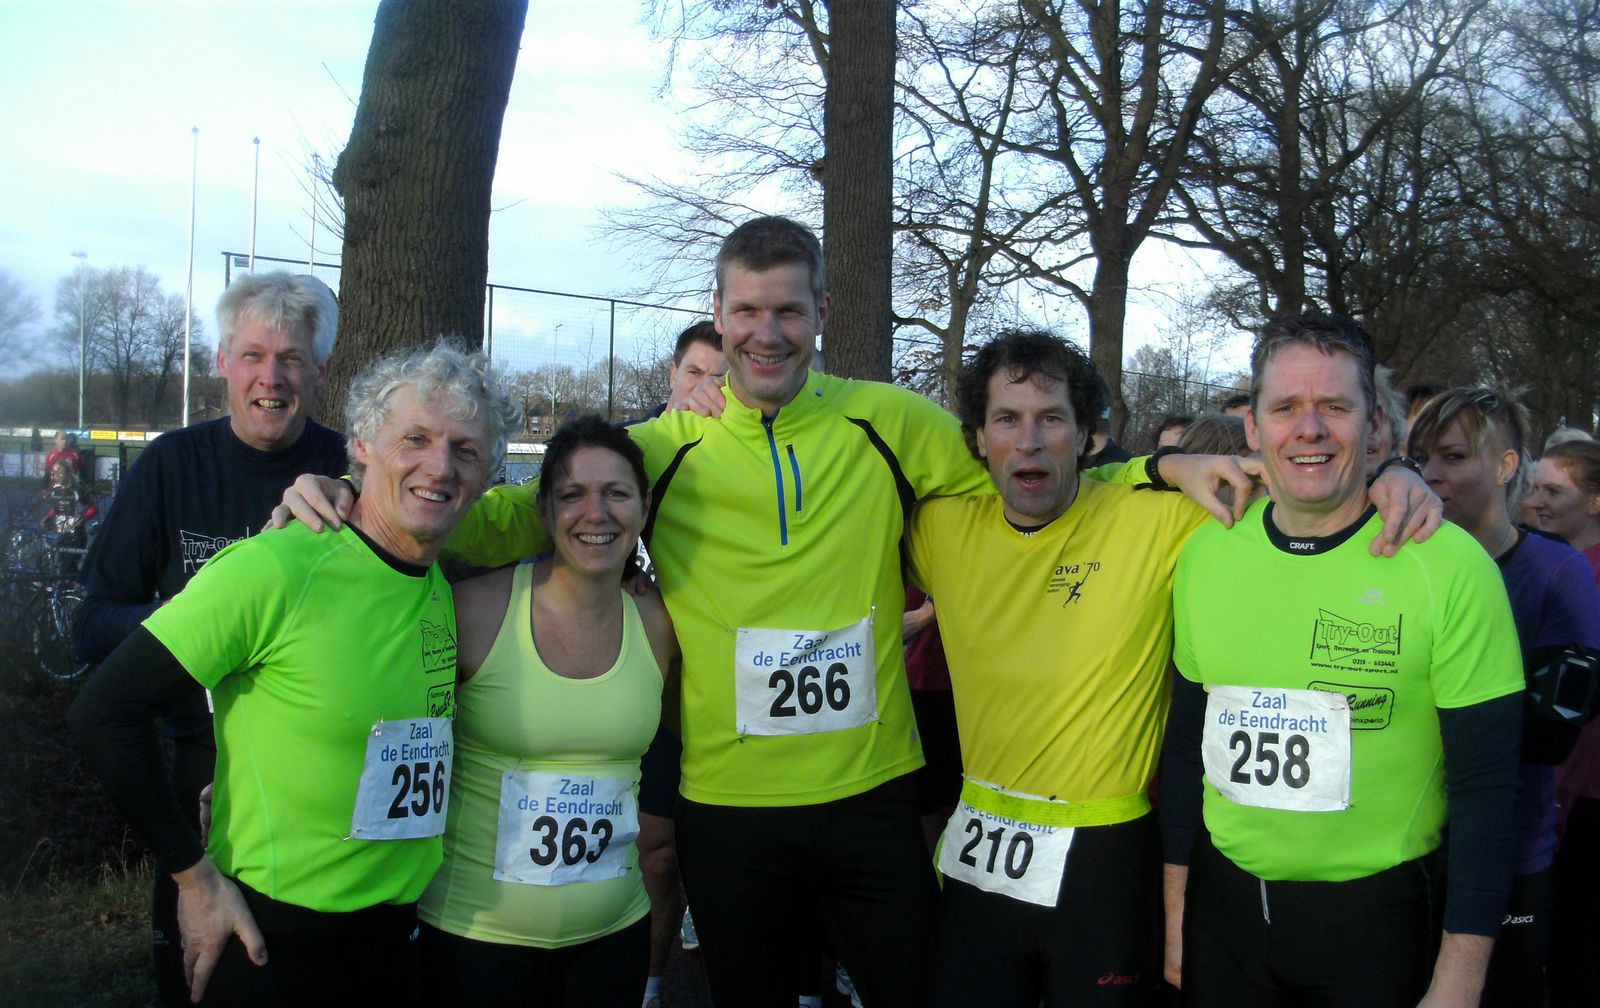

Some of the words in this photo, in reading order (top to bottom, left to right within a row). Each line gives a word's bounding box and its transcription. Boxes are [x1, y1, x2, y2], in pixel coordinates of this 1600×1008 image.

[182, 536, 244, 558] Try-O
[1055, 565, 1080, 575] ava
[793, 634, 829, 650] Zaal
[1319, 619, 1398, 645] Try-Out
[753, 651, 774, 667] de
[779, 642, 862, 667] Eendracht
[1373, 648, 1396, 656] Training
[1310, 662, 1399, 674] www.try-out-sport.nl
[768, 662, 851, 718] 266
[1251, 691, 1287, 710] Zaal
[1346, 693, 1388, 711] Running
[410, 722, 433, 740] Zaal
[1218, 709, 1236, 726] de
[1240, 710, 1328, 734] Eendracht
[381, 744, 398, 762] de
[401, 740, 450, 761] Eendracht
[1229, 730, 1311, 789] 258
[387, 760, 446, 819] 256
[559, 778, 595, 796] Zaal
[517, 795, 539, 812] de
[545, 796, 623, 816] Eendracht
[529, 815, 614, 867] 363
[958, 818, 1034, 879] 210
[1511, 915, 1534, 924] asics
